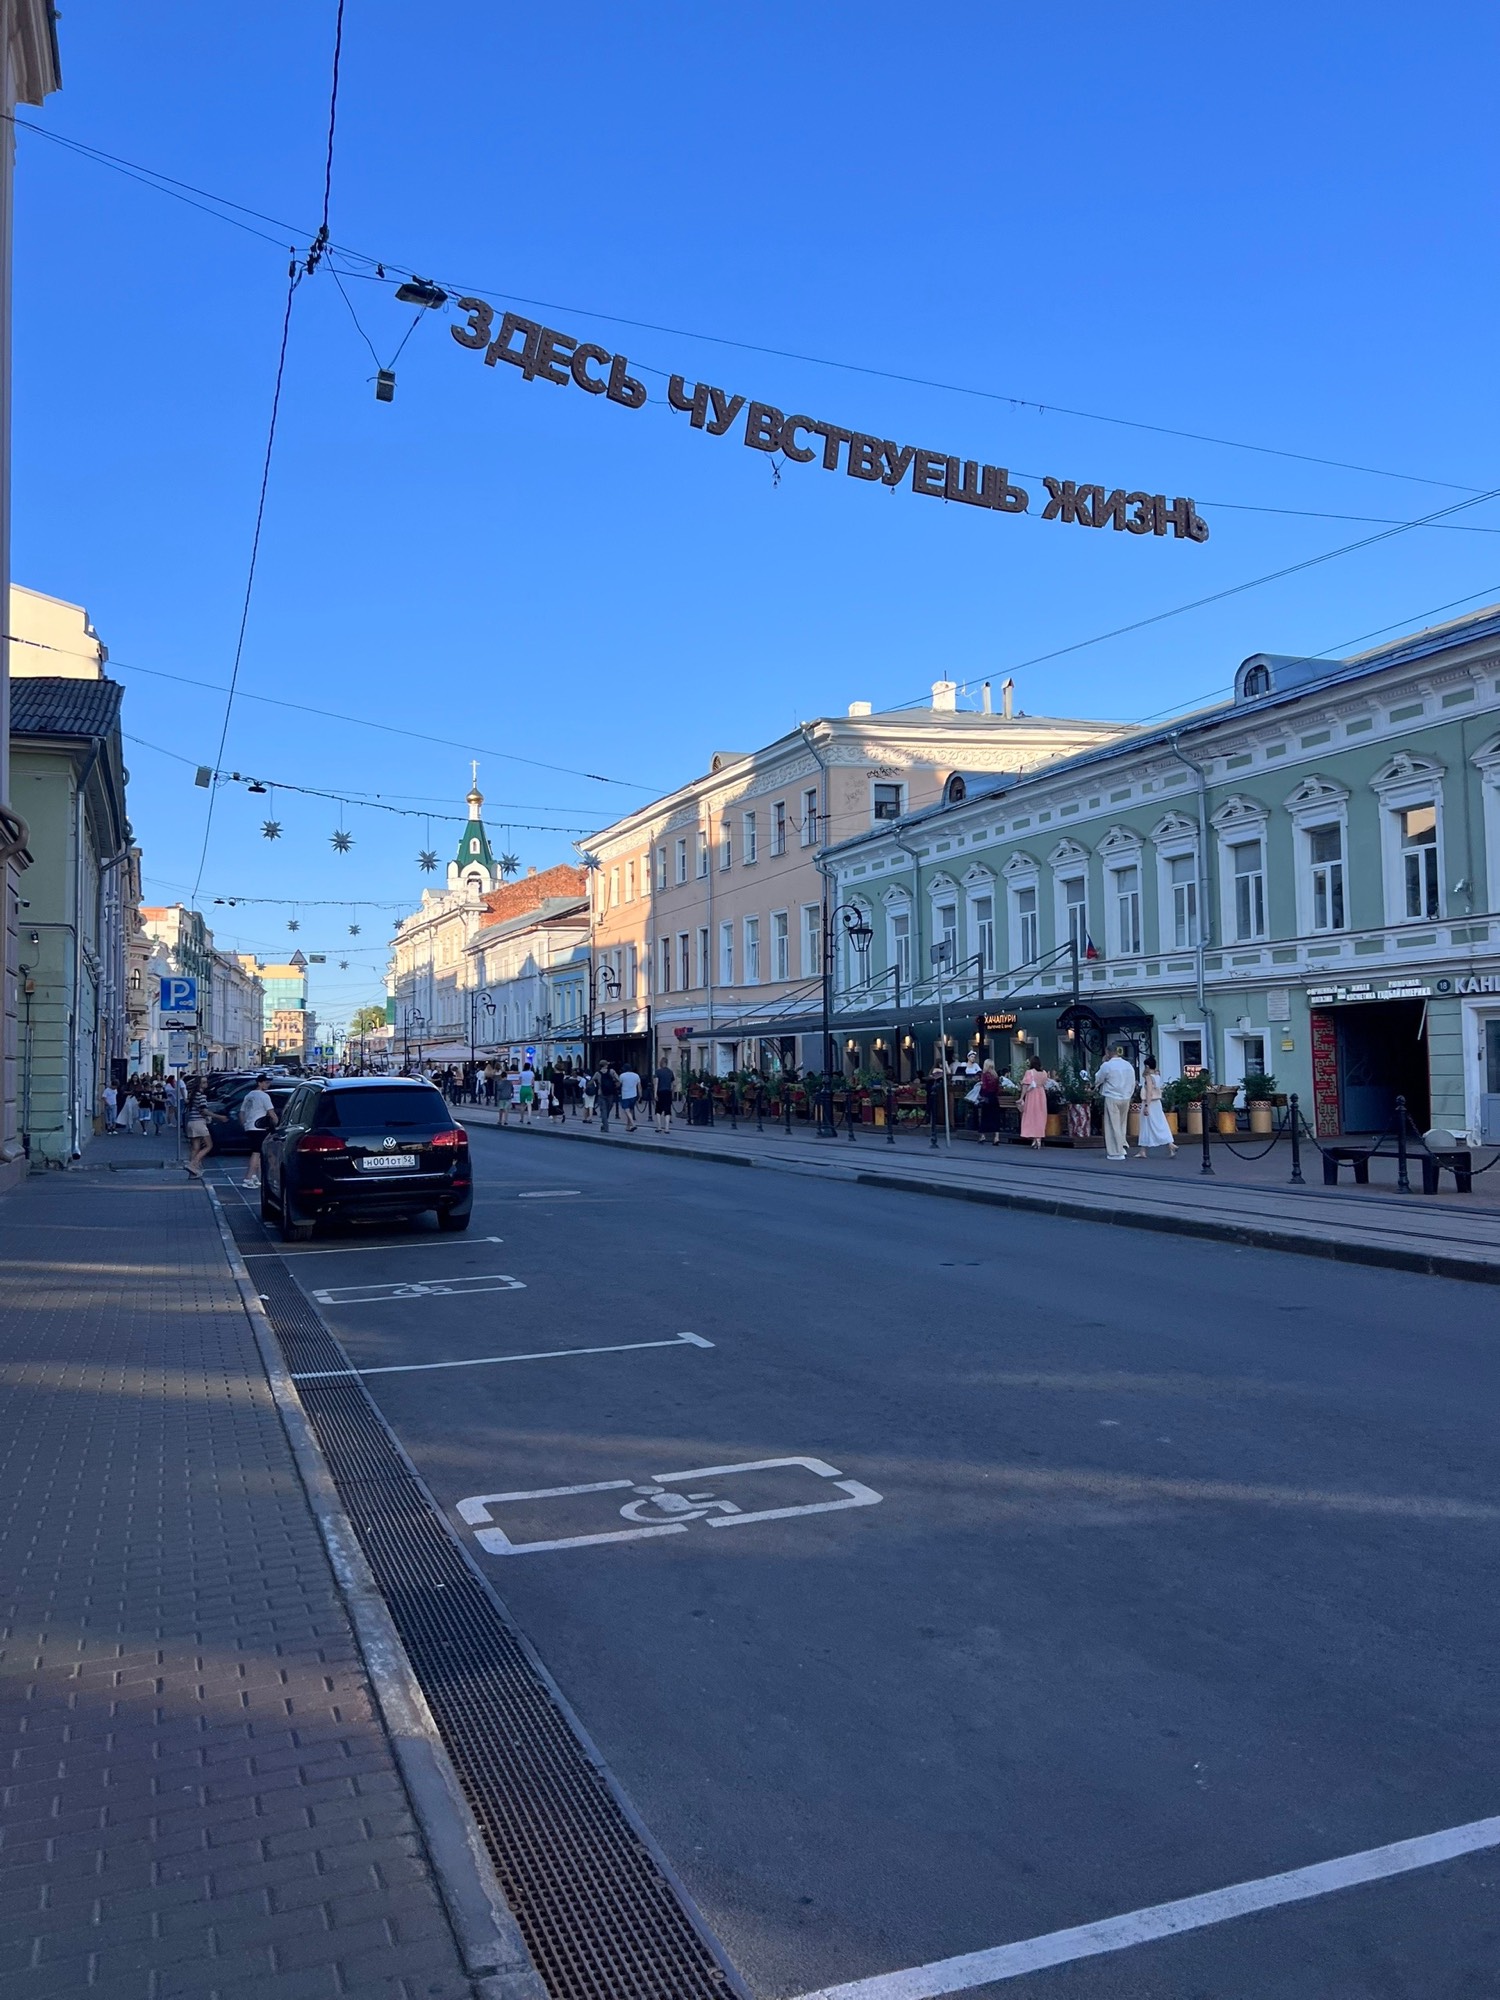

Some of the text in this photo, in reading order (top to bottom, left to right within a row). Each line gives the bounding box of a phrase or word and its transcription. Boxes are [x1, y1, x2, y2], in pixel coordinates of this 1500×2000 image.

[451, 297, 1210, 543] ЗДЕСЬ ЧУВСТВУЕШЬ ЖИЗНЬ
[170, 980, 190, 1007] P
[1440, 982, 1448, 990] 18
[984, 1014, 1016, 1024] ХАЧАПУРИ
